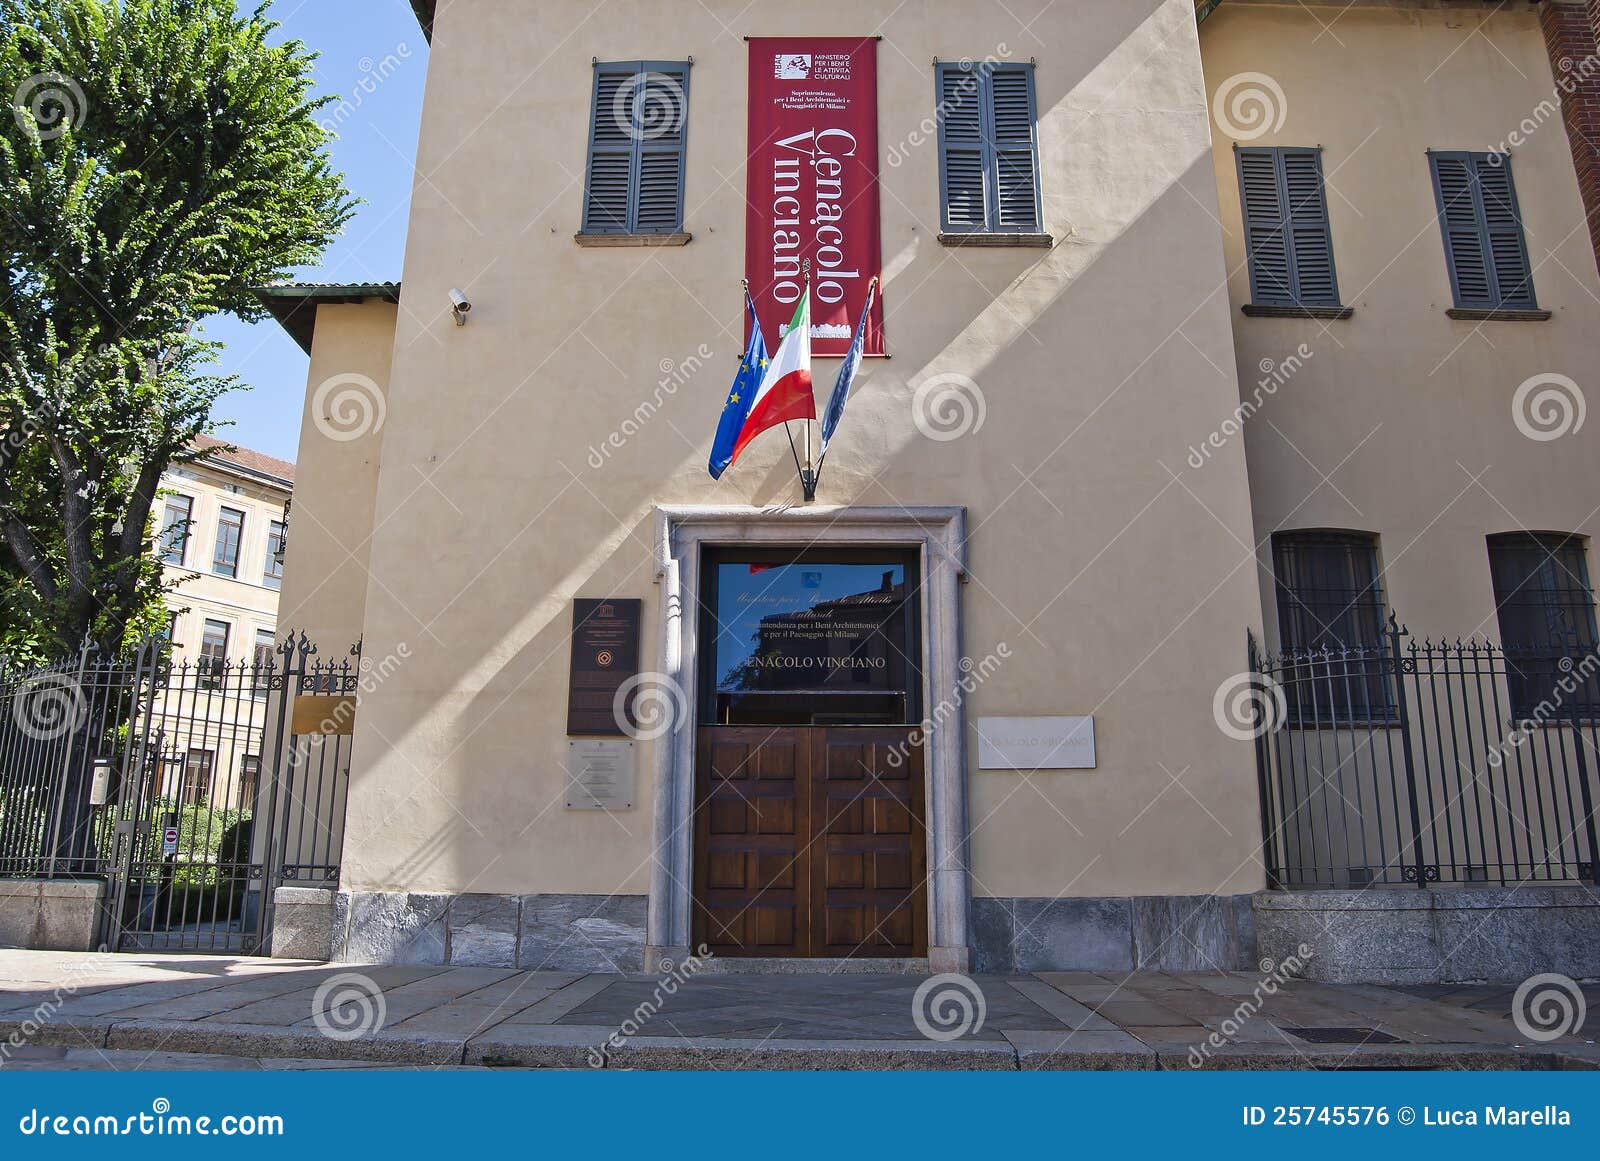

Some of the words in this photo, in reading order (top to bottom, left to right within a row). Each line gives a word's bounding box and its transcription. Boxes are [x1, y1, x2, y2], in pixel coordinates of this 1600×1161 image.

[773, 128, 816, 303] Vinciano
[814, 128, 860, 303] Cenacolo
[797, 622, 809, 632] per
[815, 621, 831, 629] Beni
[769, 632, 781, 640] per
[789, 631, 824, 640] Paesaggio
[742, 656, 813, 669] ENACOLO
[816, 656, 886, 669] VINCIANO
